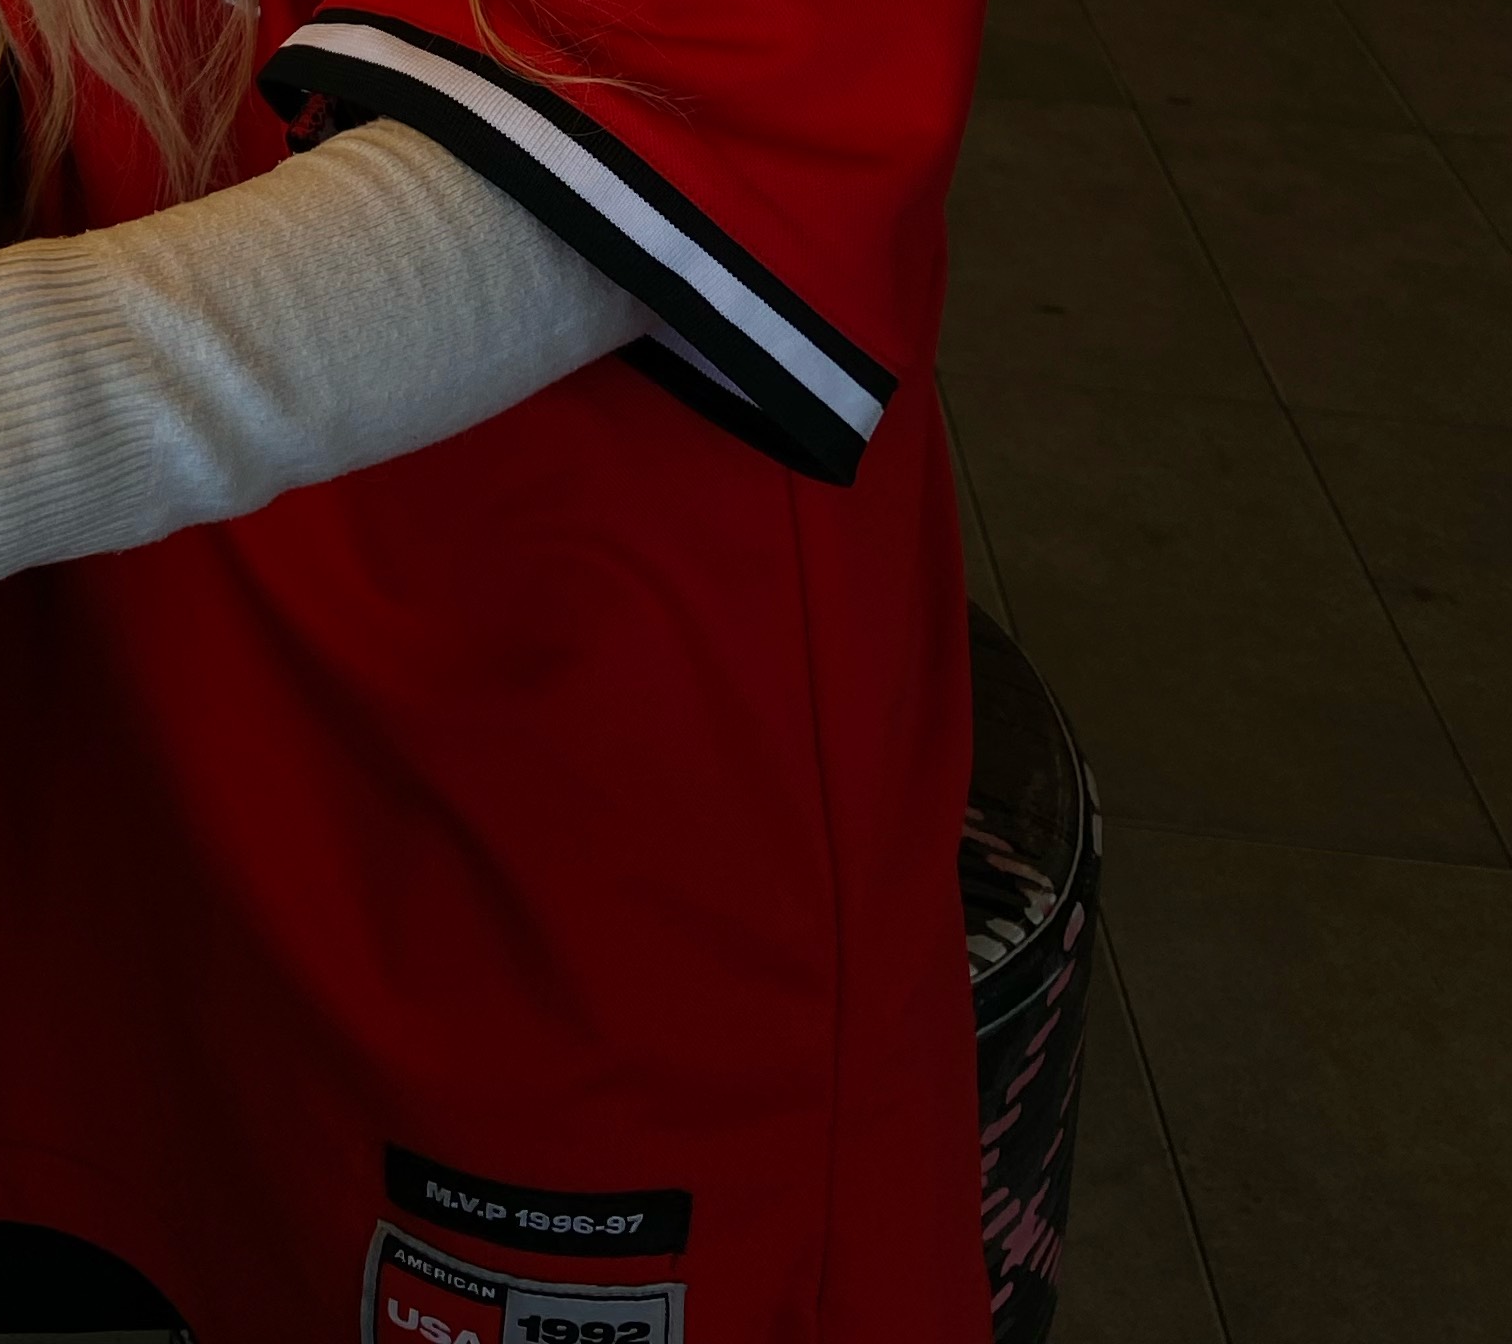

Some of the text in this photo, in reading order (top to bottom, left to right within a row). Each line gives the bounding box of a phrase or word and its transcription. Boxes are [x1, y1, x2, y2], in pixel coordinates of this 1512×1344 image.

[426, 1179, 644, 1235] M.V.P 1996-97
[394, 1248, 496, 1300] AMERICAN
[517, 1314, 652, 1344] 1992
